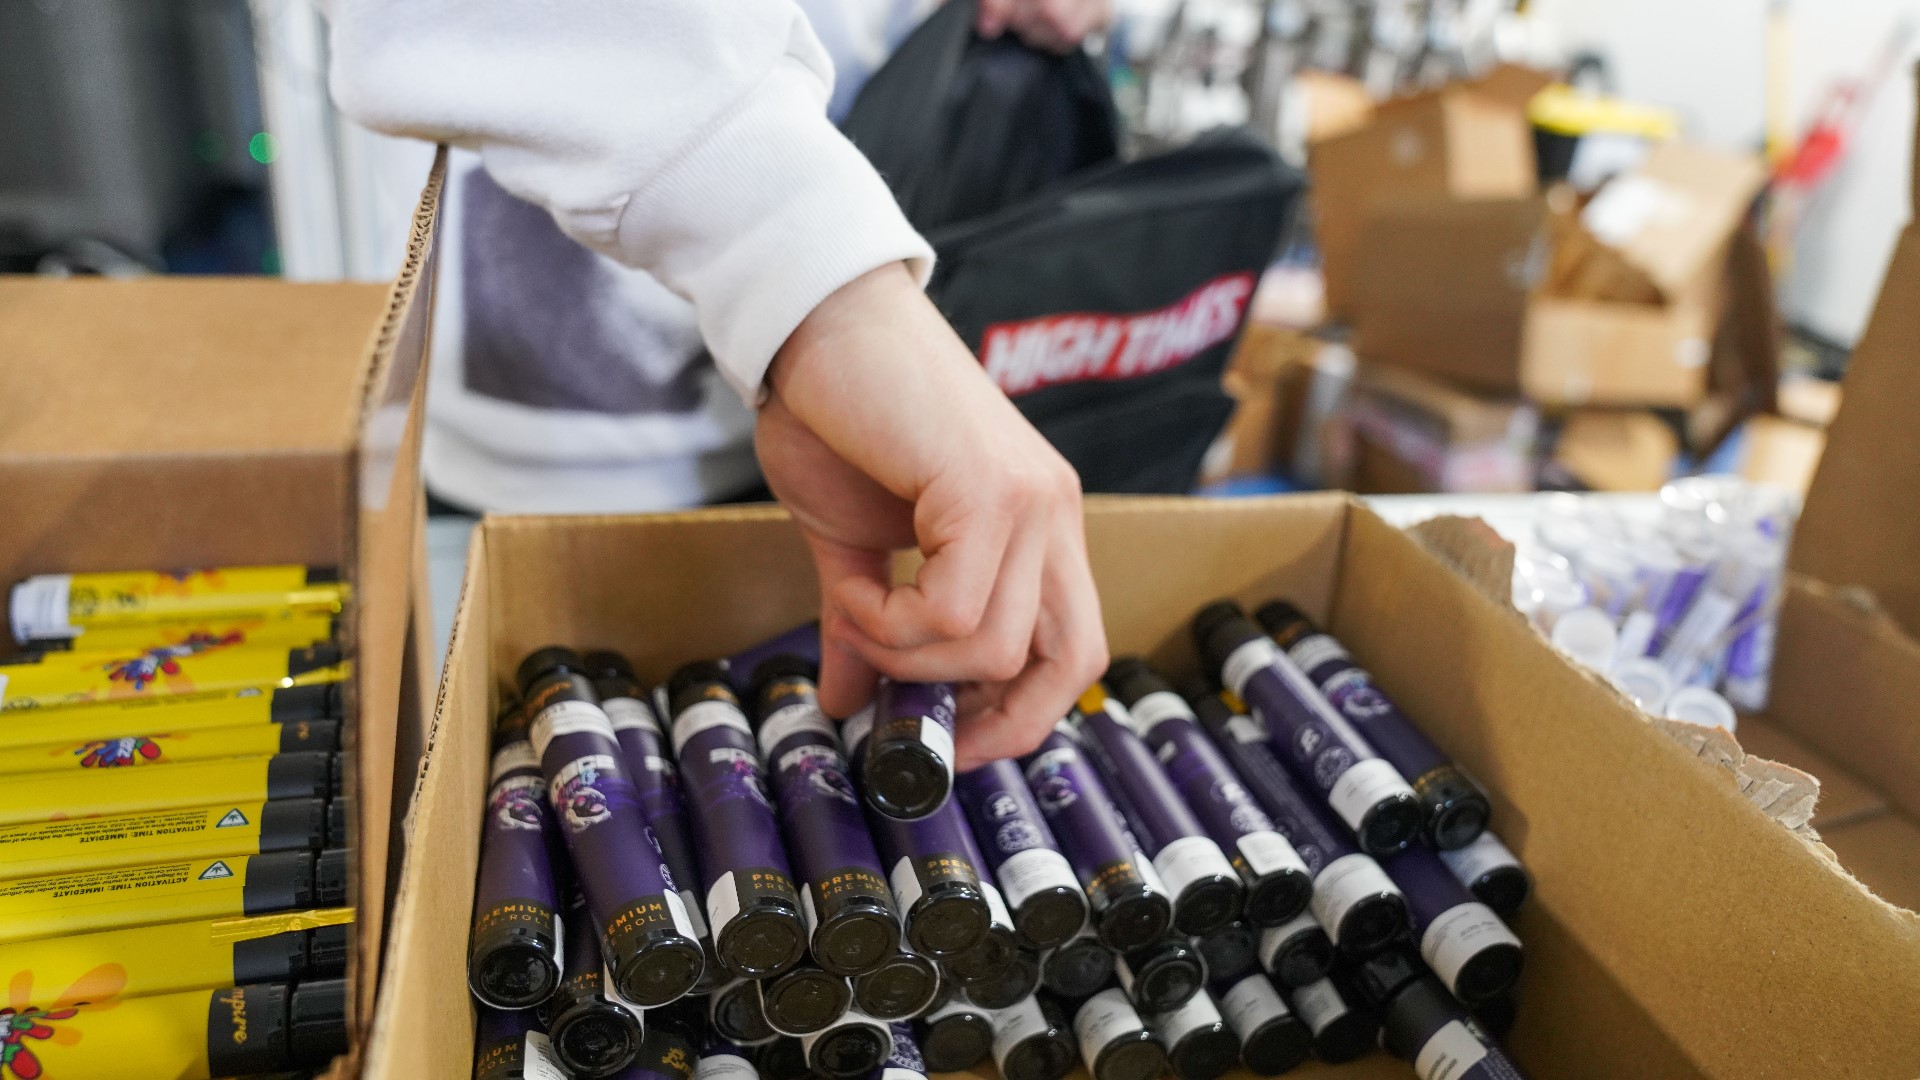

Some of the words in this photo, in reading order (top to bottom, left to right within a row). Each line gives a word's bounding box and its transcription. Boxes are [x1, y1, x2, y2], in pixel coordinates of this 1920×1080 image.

[981, 318, 1124, 393] HIGH
[1116, 273, 1253, 377] TIMES
[156, 824, 206, 834] ACTIVATION
[79, 832, 127, 842] IMMEDIATE
[106, 882, 131, 891] TIME:
[134, 876, 188, 888] ACTIVATION
[52, 886, 104, 897] IMMEDIATE
